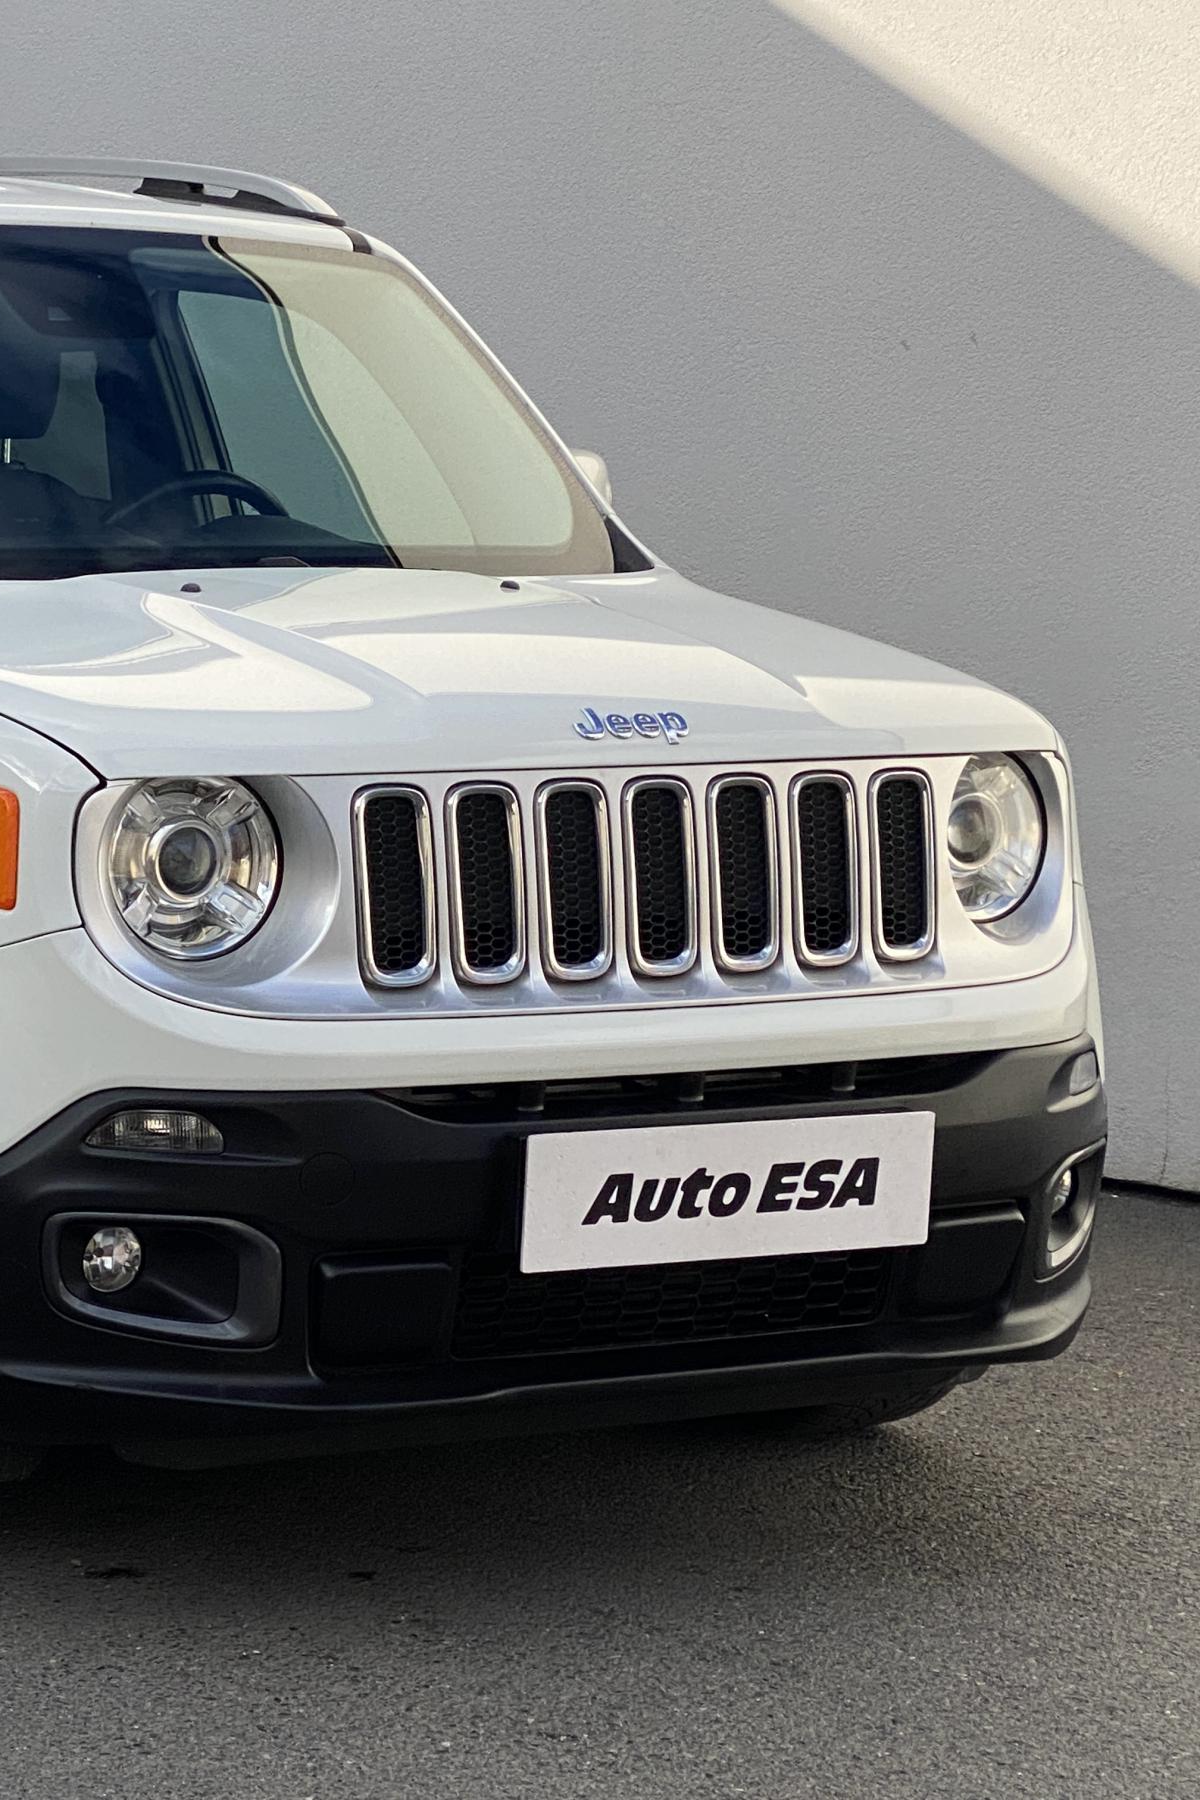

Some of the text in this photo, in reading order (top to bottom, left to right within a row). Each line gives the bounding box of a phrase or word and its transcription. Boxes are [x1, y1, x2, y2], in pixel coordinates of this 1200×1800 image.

[573, 708, 689, 745] Jeep
[582, 1157, 880, 1225] Auto ESA
